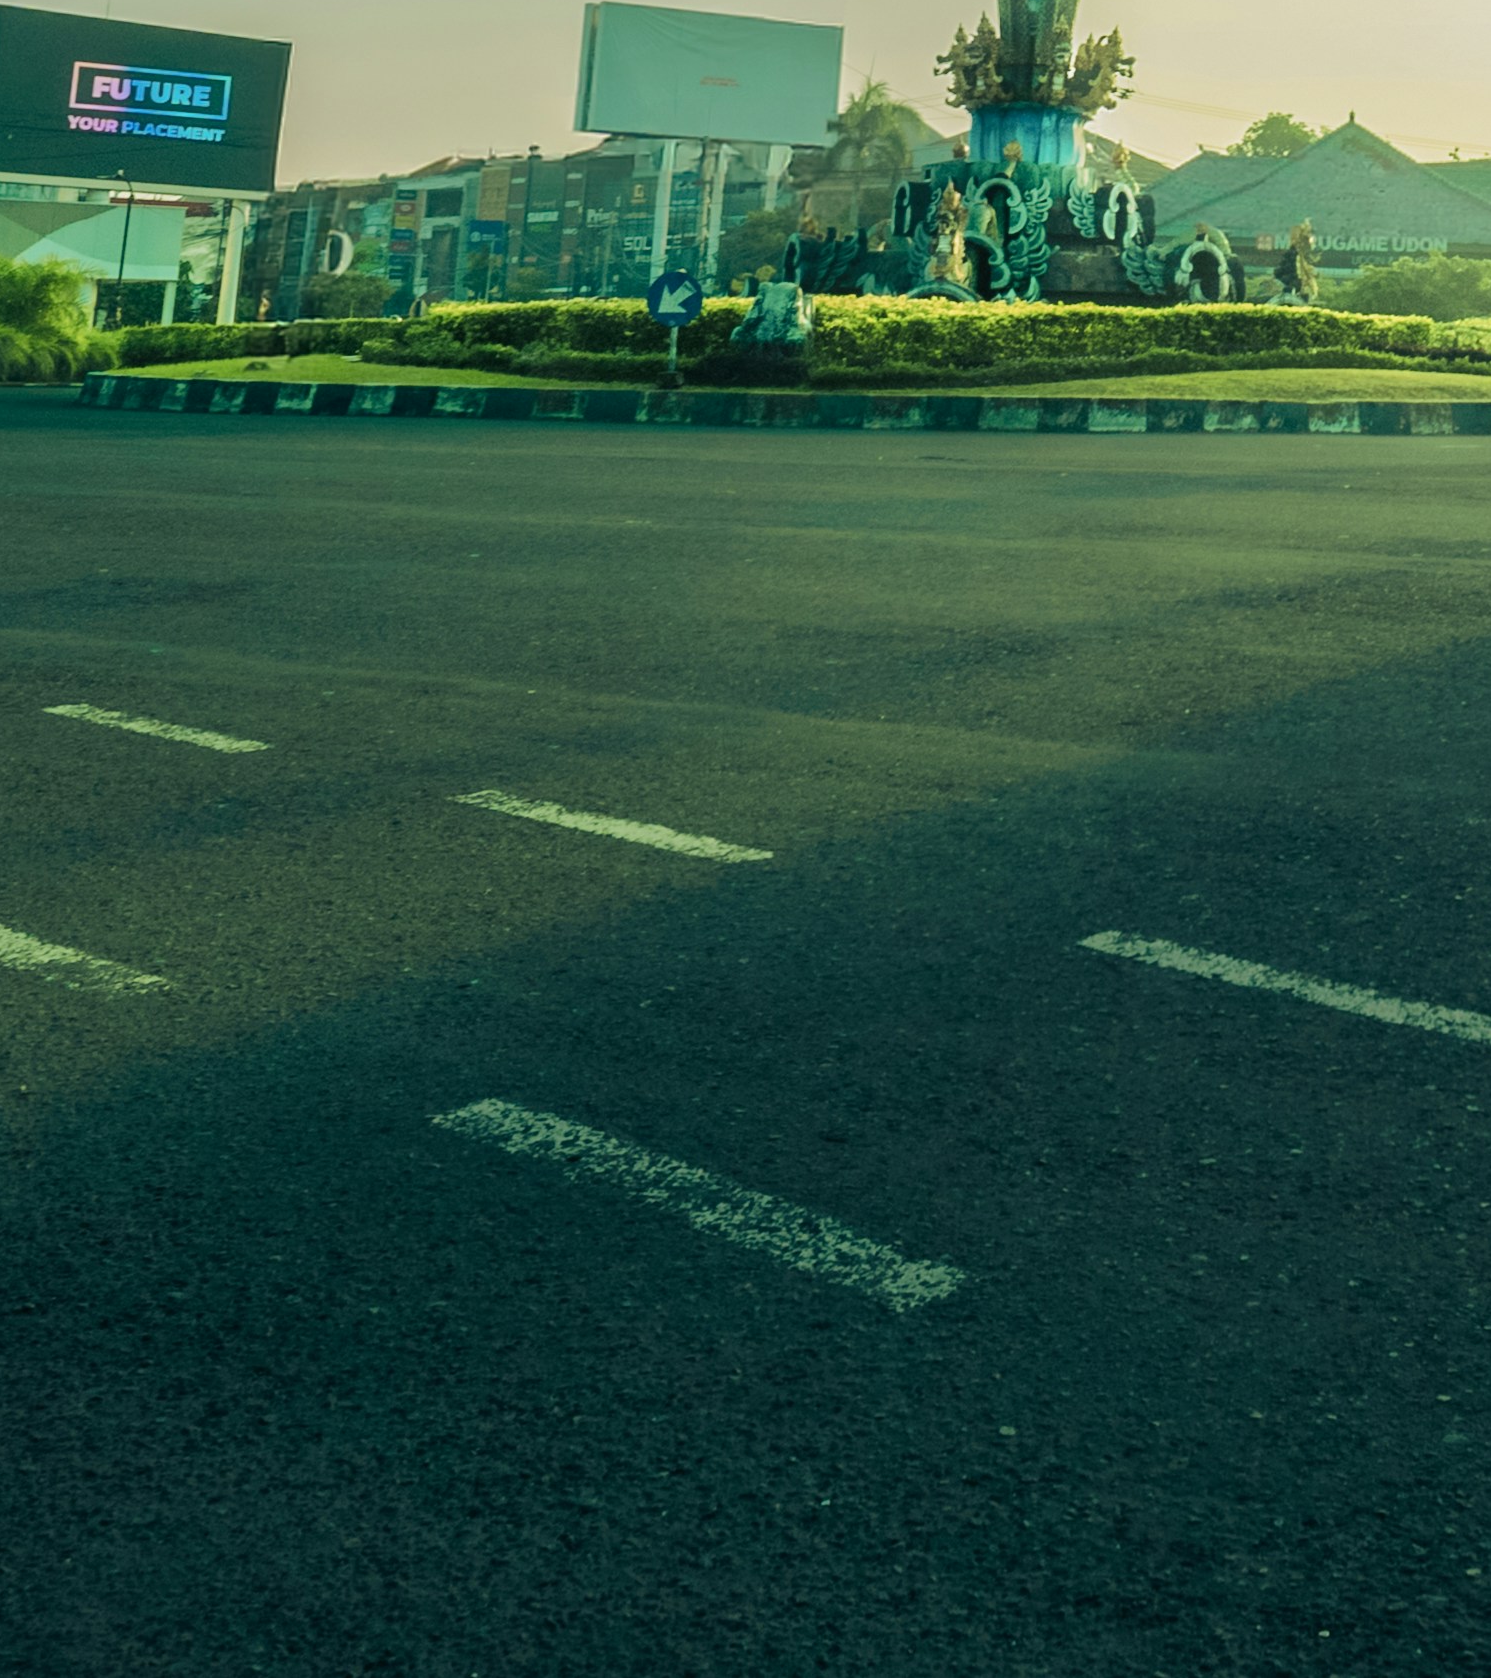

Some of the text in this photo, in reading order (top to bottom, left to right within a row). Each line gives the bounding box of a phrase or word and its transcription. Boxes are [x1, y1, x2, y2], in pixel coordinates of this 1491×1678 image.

[91, 75, 212, 108] FUTURE
[67, 115, 226, 143] YOUR PLACEMENT
[1274, 234, 1448, 253] MUGAME UDON
